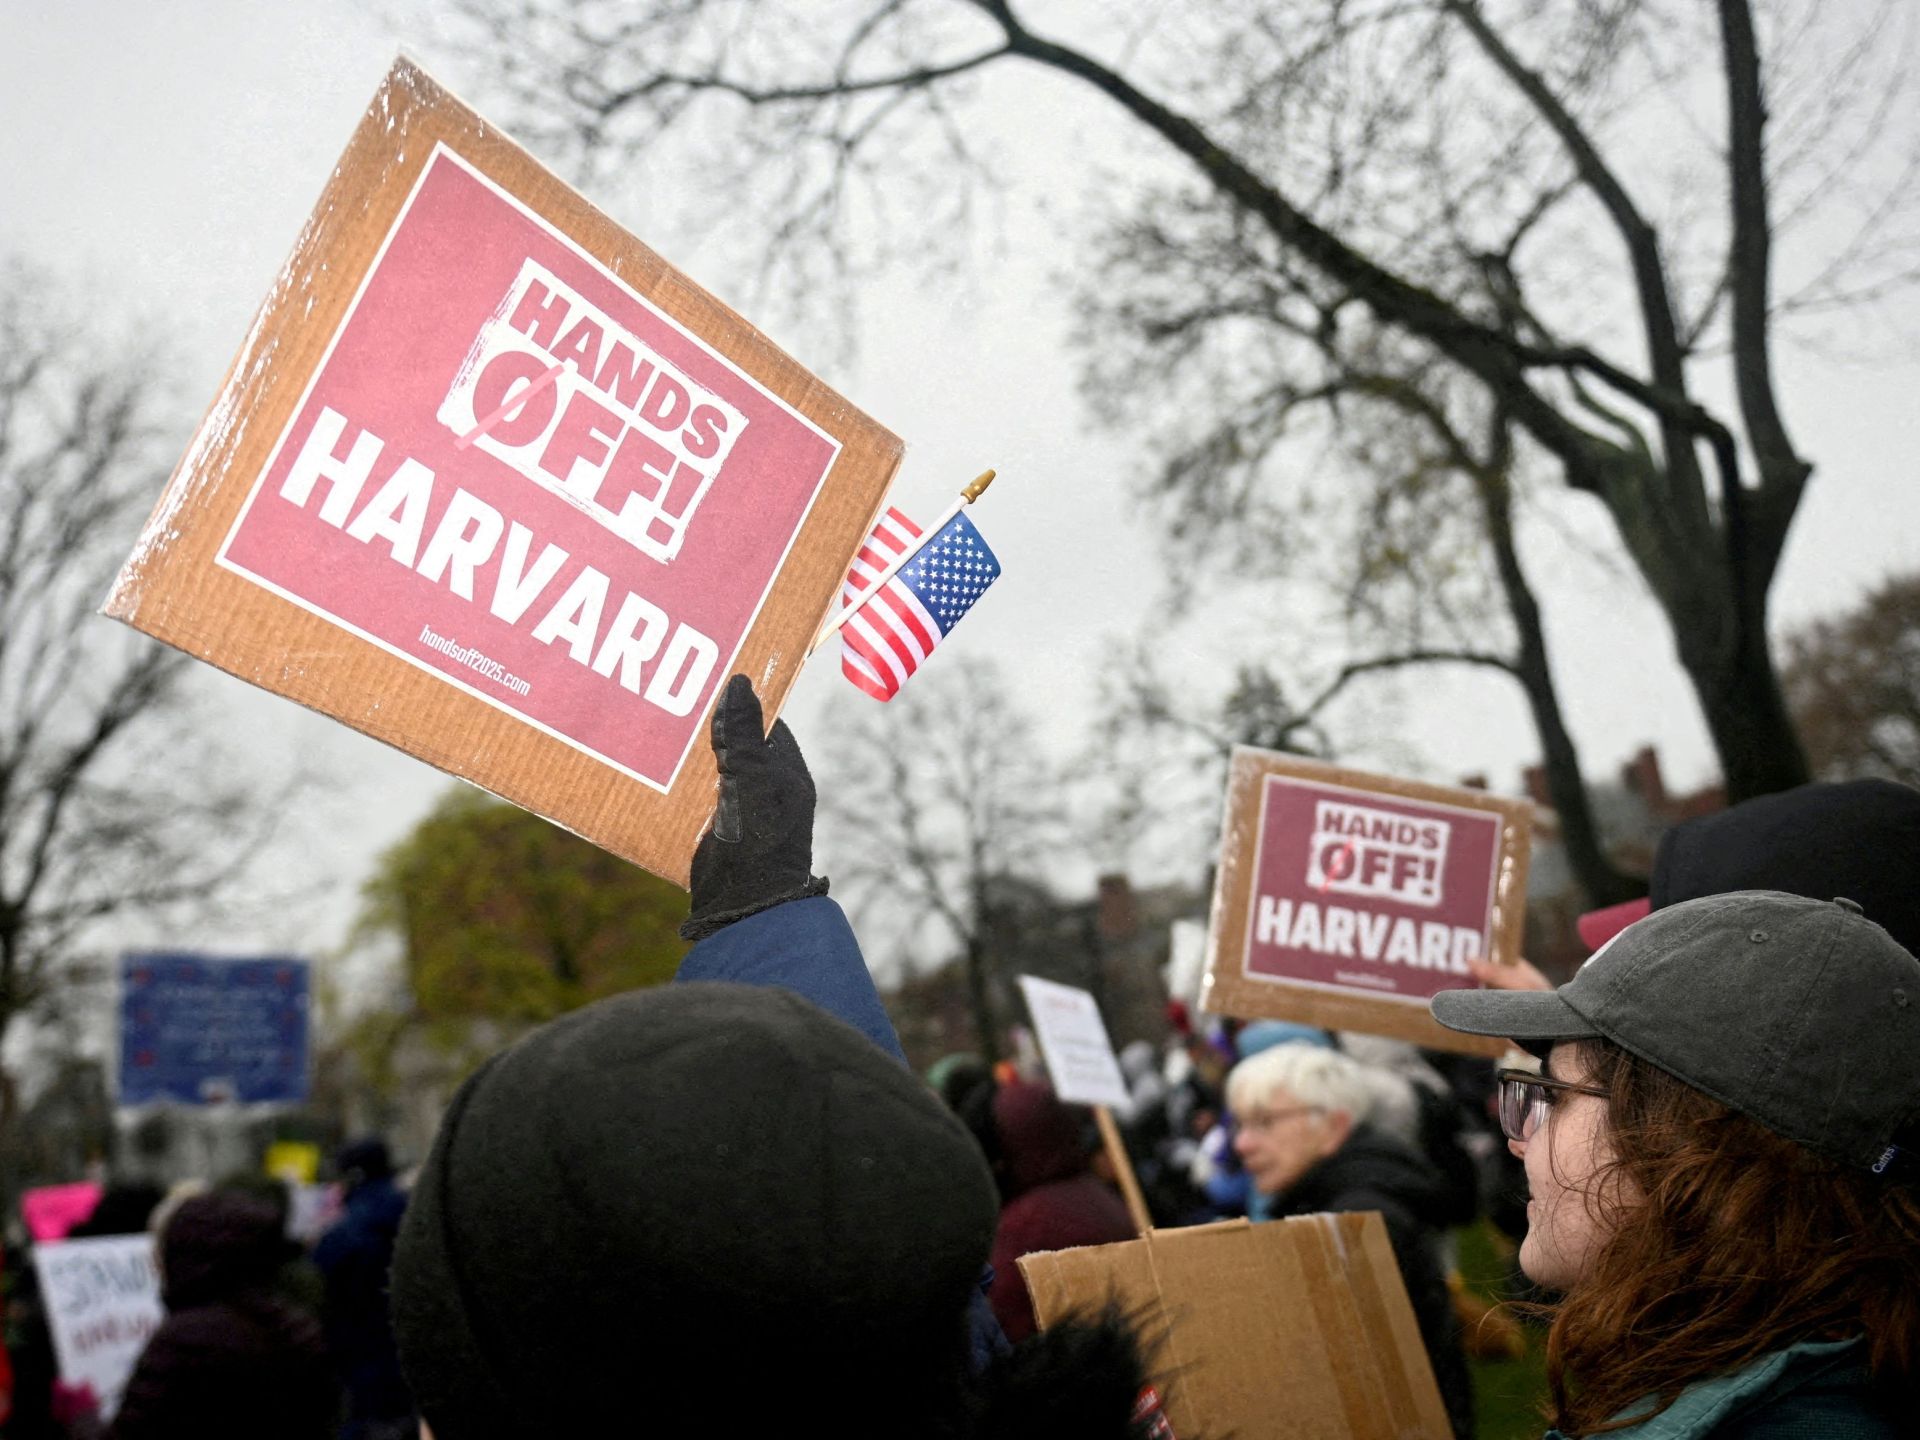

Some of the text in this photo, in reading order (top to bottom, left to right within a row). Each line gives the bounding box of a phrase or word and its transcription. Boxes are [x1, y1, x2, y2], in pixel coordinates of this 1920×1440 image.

[507, 278, 729, 461] HANDS
[471, 350, 706, 547] OFF!
[278, 405, 720, 718] HARVARD
[418, 624, 532, 697] handsoff2025.com
[1318, 841, 1441, 897] OFF!
[1322, 808, 1441, 850] HANDS
[1255, 895, 1483, 976] HARVARD
